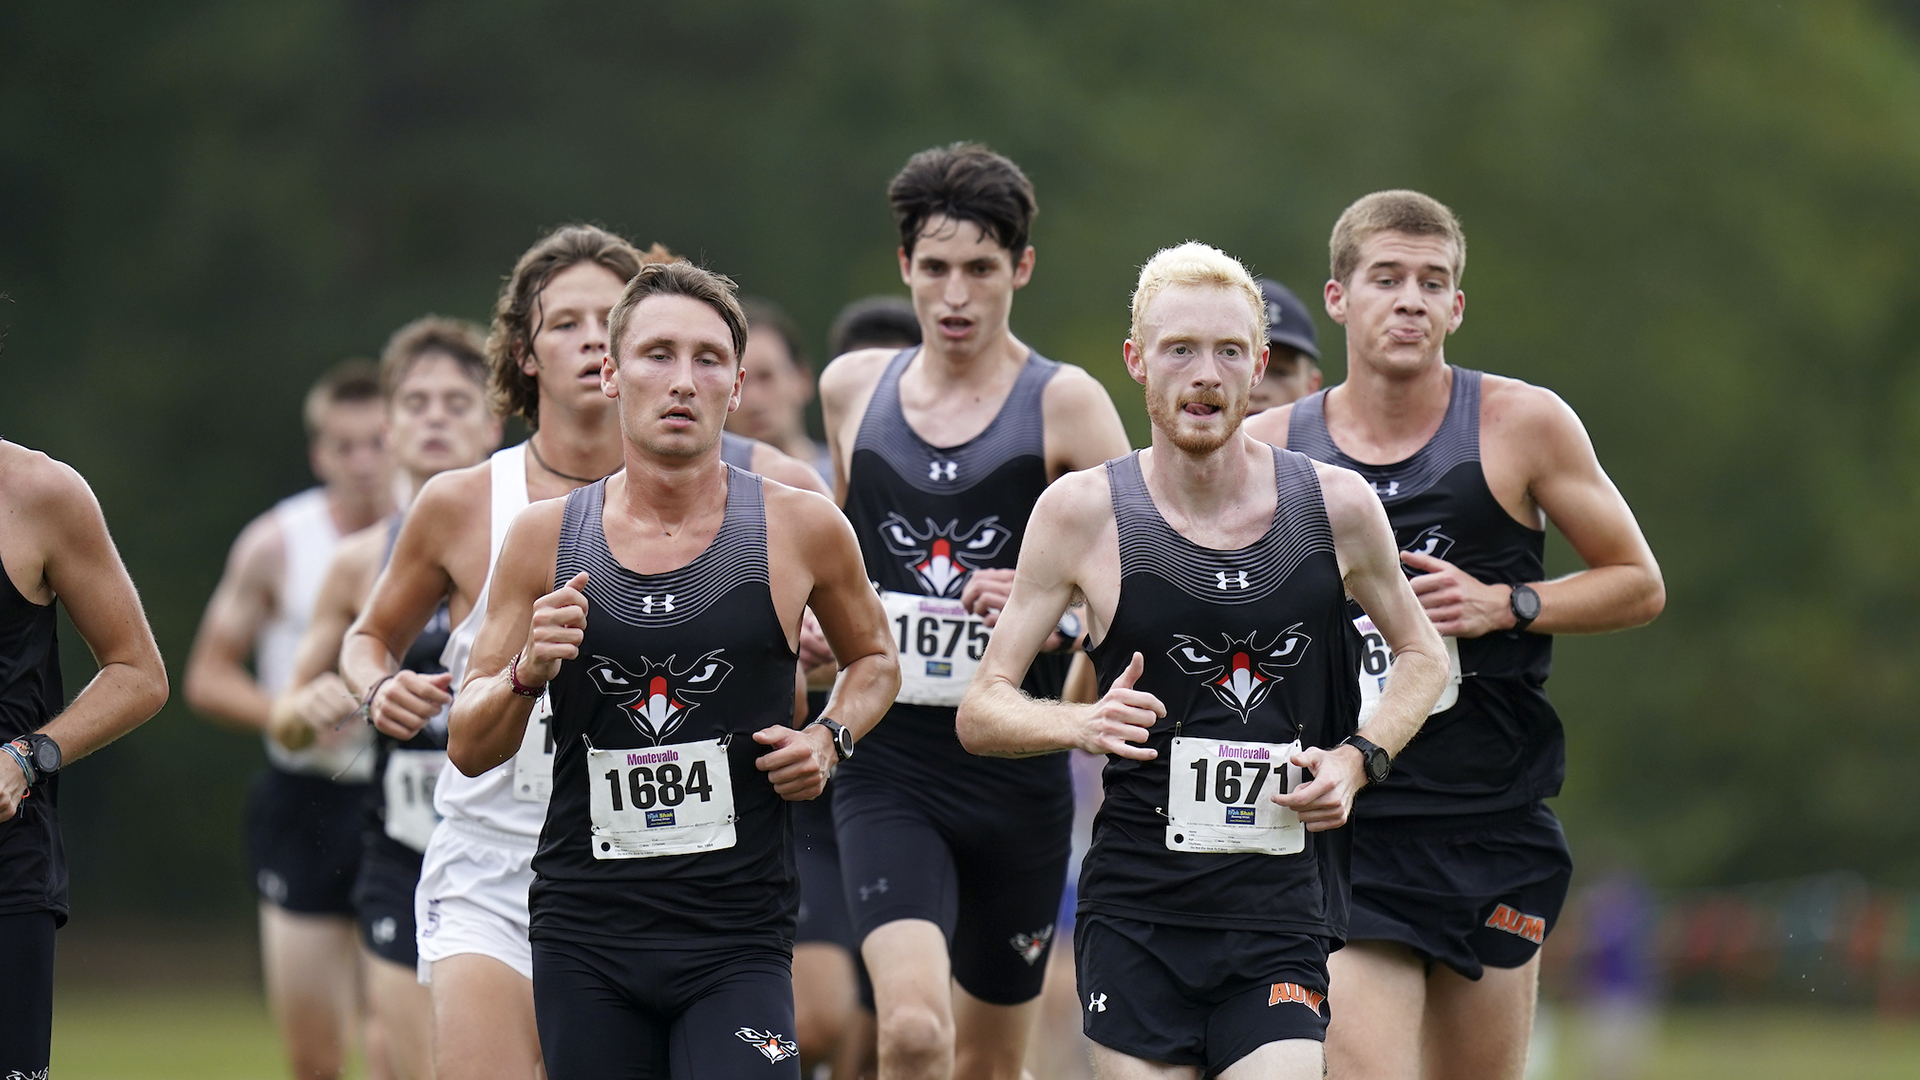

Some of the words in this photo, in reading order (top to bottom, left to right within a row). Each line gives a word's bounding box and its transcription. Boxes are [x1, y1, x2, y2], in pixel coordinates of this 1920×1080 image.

[895, 614, 991, 662] 1675
[627, 750, 679, 766] Montevallo
[1218, 744, 1270, 760] Montevallo
[605, 760, 713, 811] 1684
[1190, 758, 1288, 805] 1671
[1486, 903, 1546, 945] AUM
[1268, 982, 1326, 1018] AUM
